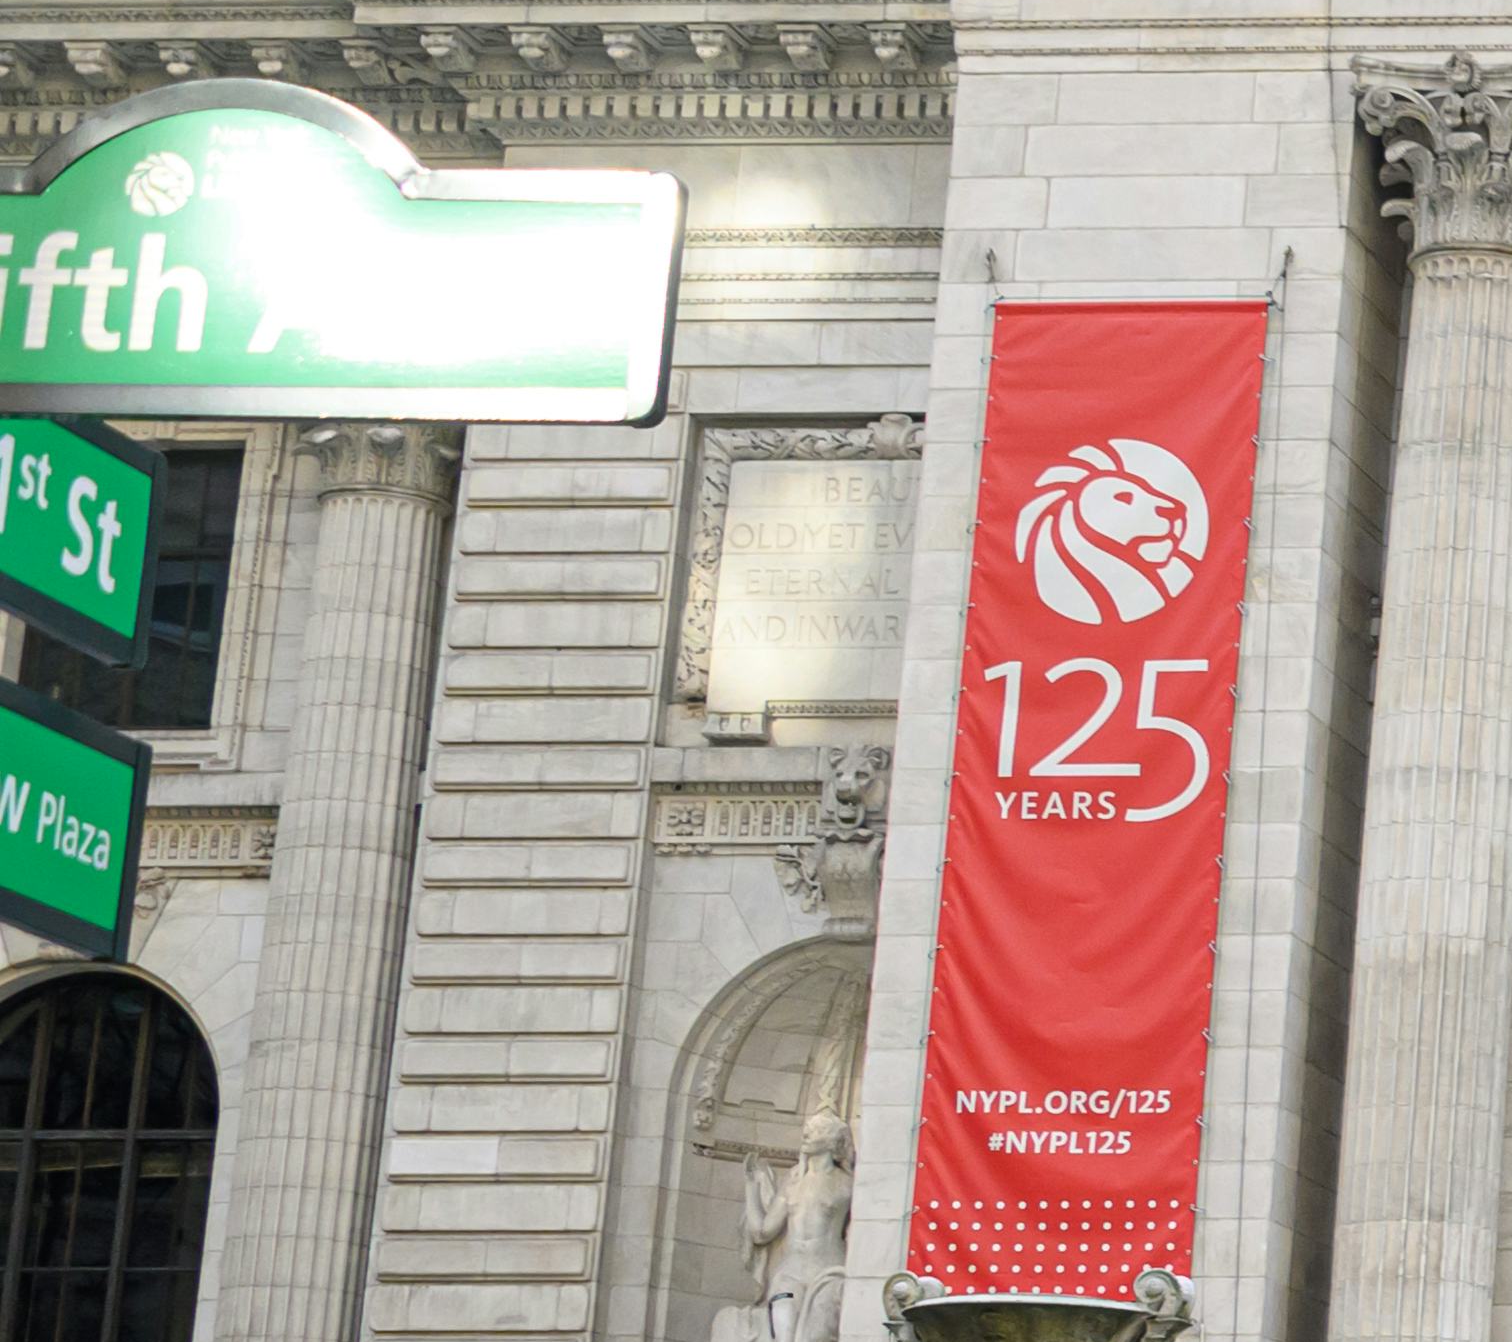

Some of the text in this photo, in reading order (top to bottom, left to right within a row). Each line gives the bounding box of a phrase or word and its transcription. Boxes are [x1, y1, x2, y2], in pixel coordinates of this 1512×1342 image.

[824, 477, 921, 503] BEAU
[61, 475, 121, 594] St
[728, 523, 797, 550] OLD
[803, 523, 864, 549] YET
[746, 569, 899, 595] ETERNAL
[717, 616, 786, 642] AND
[983, 658, 1211, 823] 125
[995, 791, 1117, 821] YEARS
[36, 790, 111, 871] Plaza
[955, 1089, 1172, 1119] NYPL.ORG/125
[988, 1130, 1132, 1156] #NYPL125
